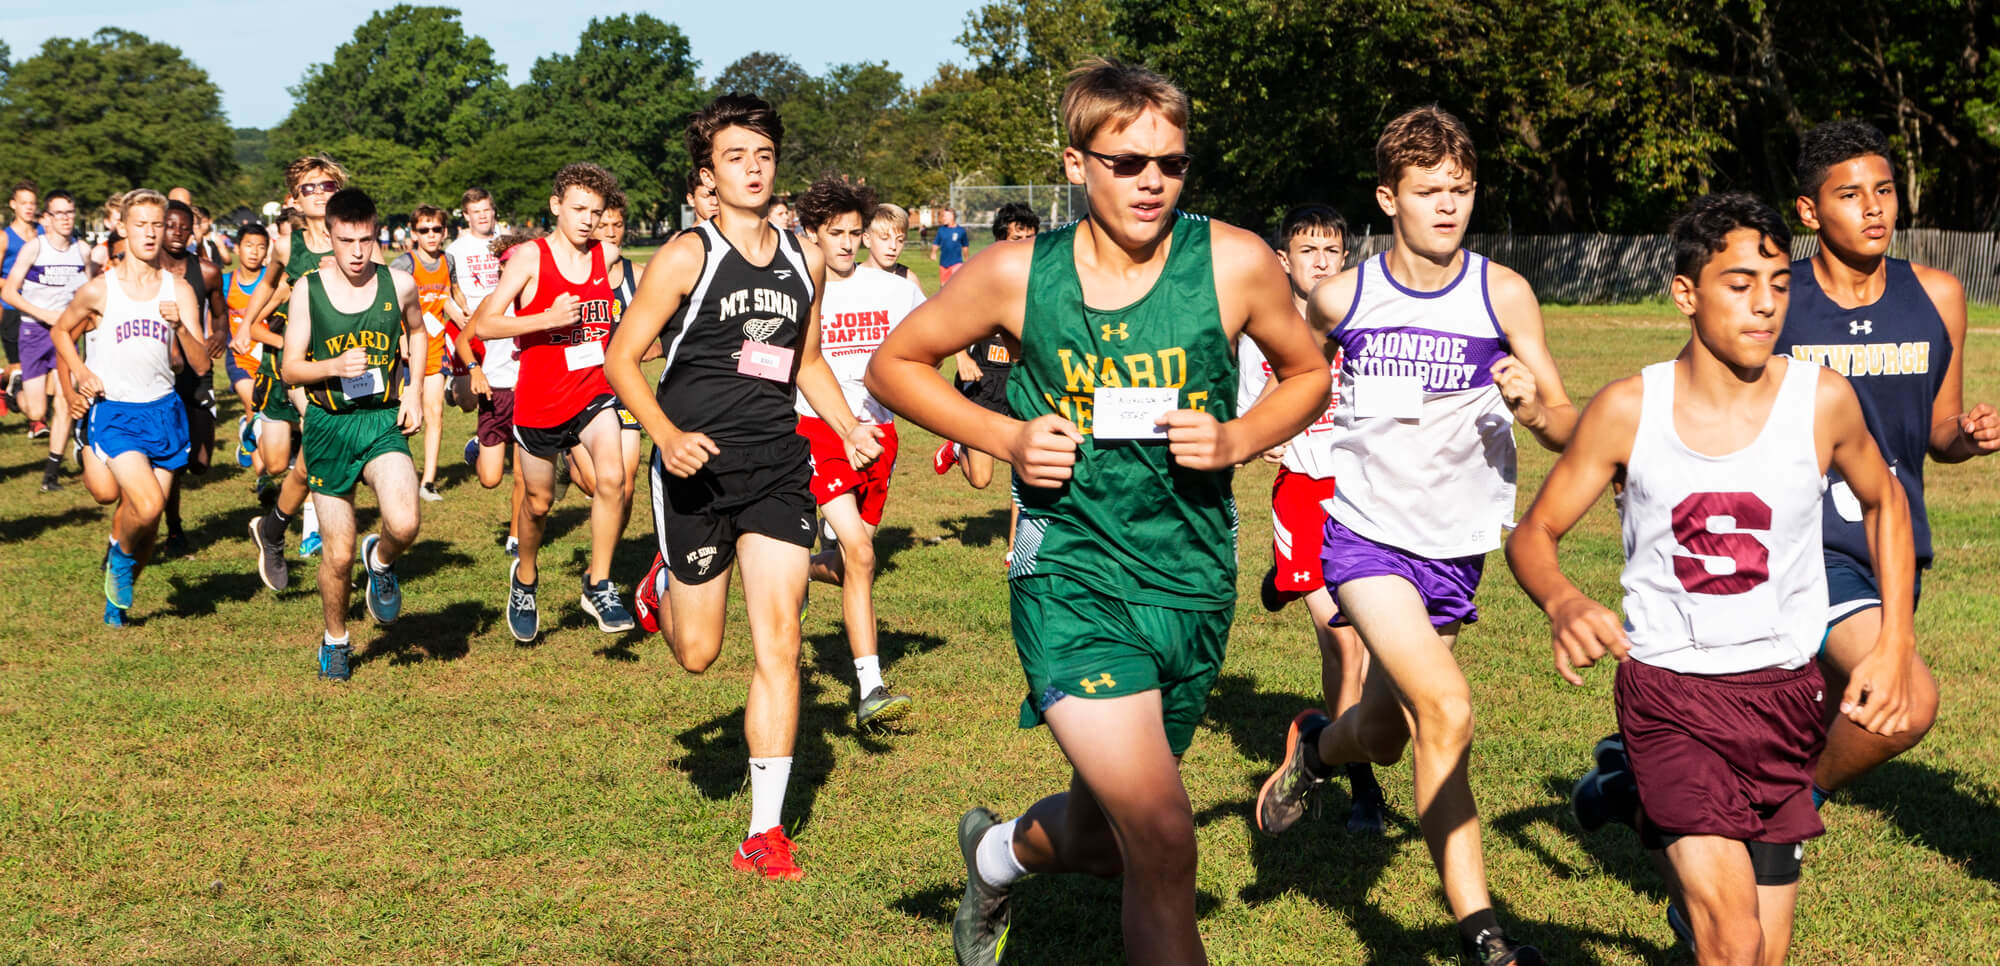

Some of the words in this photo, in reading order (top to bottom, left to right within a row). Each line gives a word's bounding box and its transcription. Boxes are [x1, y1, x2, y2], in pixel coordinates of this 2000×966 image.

[719, 290, 750, 322] MT.
[753, 288, 799, 323] SINAI
[831, 310, 890, 329] JOHN
[325, 330, 390, 356] WARD
[827, 326, 890, 344] BAPTIST
[1360, 332, 1468, 364] MONROE
[1057, 346, 1187, 393] WARD
[1671, 491, 1773, 595] S
